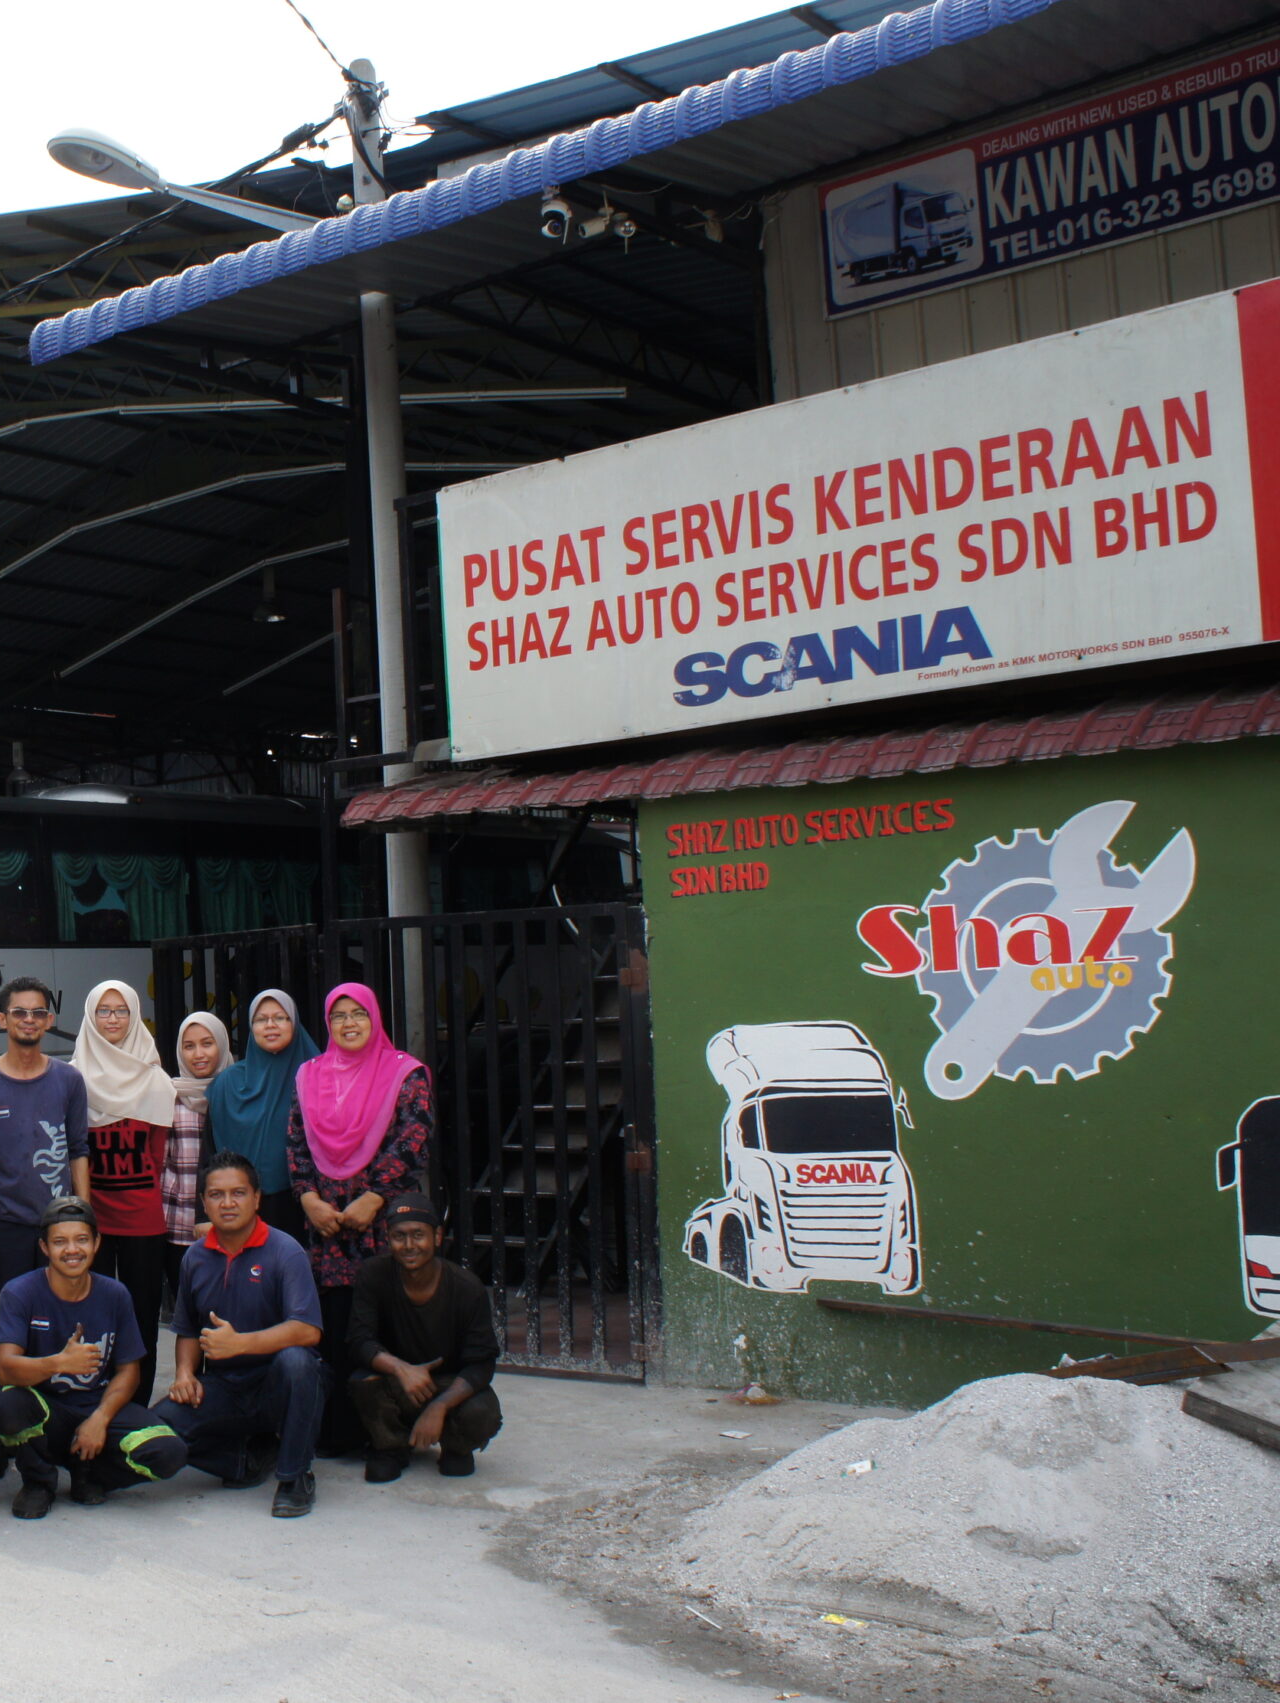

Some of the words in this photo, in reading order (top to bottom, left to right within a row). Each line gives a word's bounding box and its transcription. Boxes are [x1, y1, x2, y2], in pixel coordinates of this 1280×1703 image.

[982, 127, 1040, 157] DEALING
[1042, 113, 1076, 138] WITH
[1080, 103, 1115, 128] NEW,
[1118, 89, 1157, 114] USED
[1161, 85, 1172, 101] &
[1175, 62, 1242, 97] REBUILD
[1245, 48, 1280, 73] TRU
[984, 123, 1138, 229] KAWAN
[1152, 76, 1280, 183] AUTO
[989, 188, 1181, 264] TEL:016-323
[1192, 161, 1277, 209] 5698
[463, 525, 606, 608] PUSAT
[622, 483, 794, 576] SERVIS
[813, 389, 1213, 536] KENDERAAN
[467, 606, 572, 671] SHAZ
[586, 581, 701, 651] AUTO
[715, 533, 939, 627] SERVICES
[958, 506, 1072, 583] SDN
[1094, 480, 1218, 559] BHD
[673, 605, 993, 708] SCANIA
[917, 666, 960, 681] Formerly
[961, 663, 996, 675] Known
[997, 661, 1010, 670] as
[1012, 655, 1036, 667] KMK
[1038, 642, 1119, 663] MOTORWORKS
[1121, 639, 1146, 651] SDN
[1148, 635, 1173, 647] BHD
[1178, 626, 1231, 642] 955076-X
[666, 819, 730, 858] SHAZ
[733, 813, 799, 851] AUTO
[804, 798, 956, 845] SERVICES
[670, 865, 717, 898] SDN
[719, 861, 769, 894] BHD
[857, 904, 1138, 977] Shaz
[1030, 955, 1133, 991] auto
[796, 1163, 877, 1184] SCANIA
